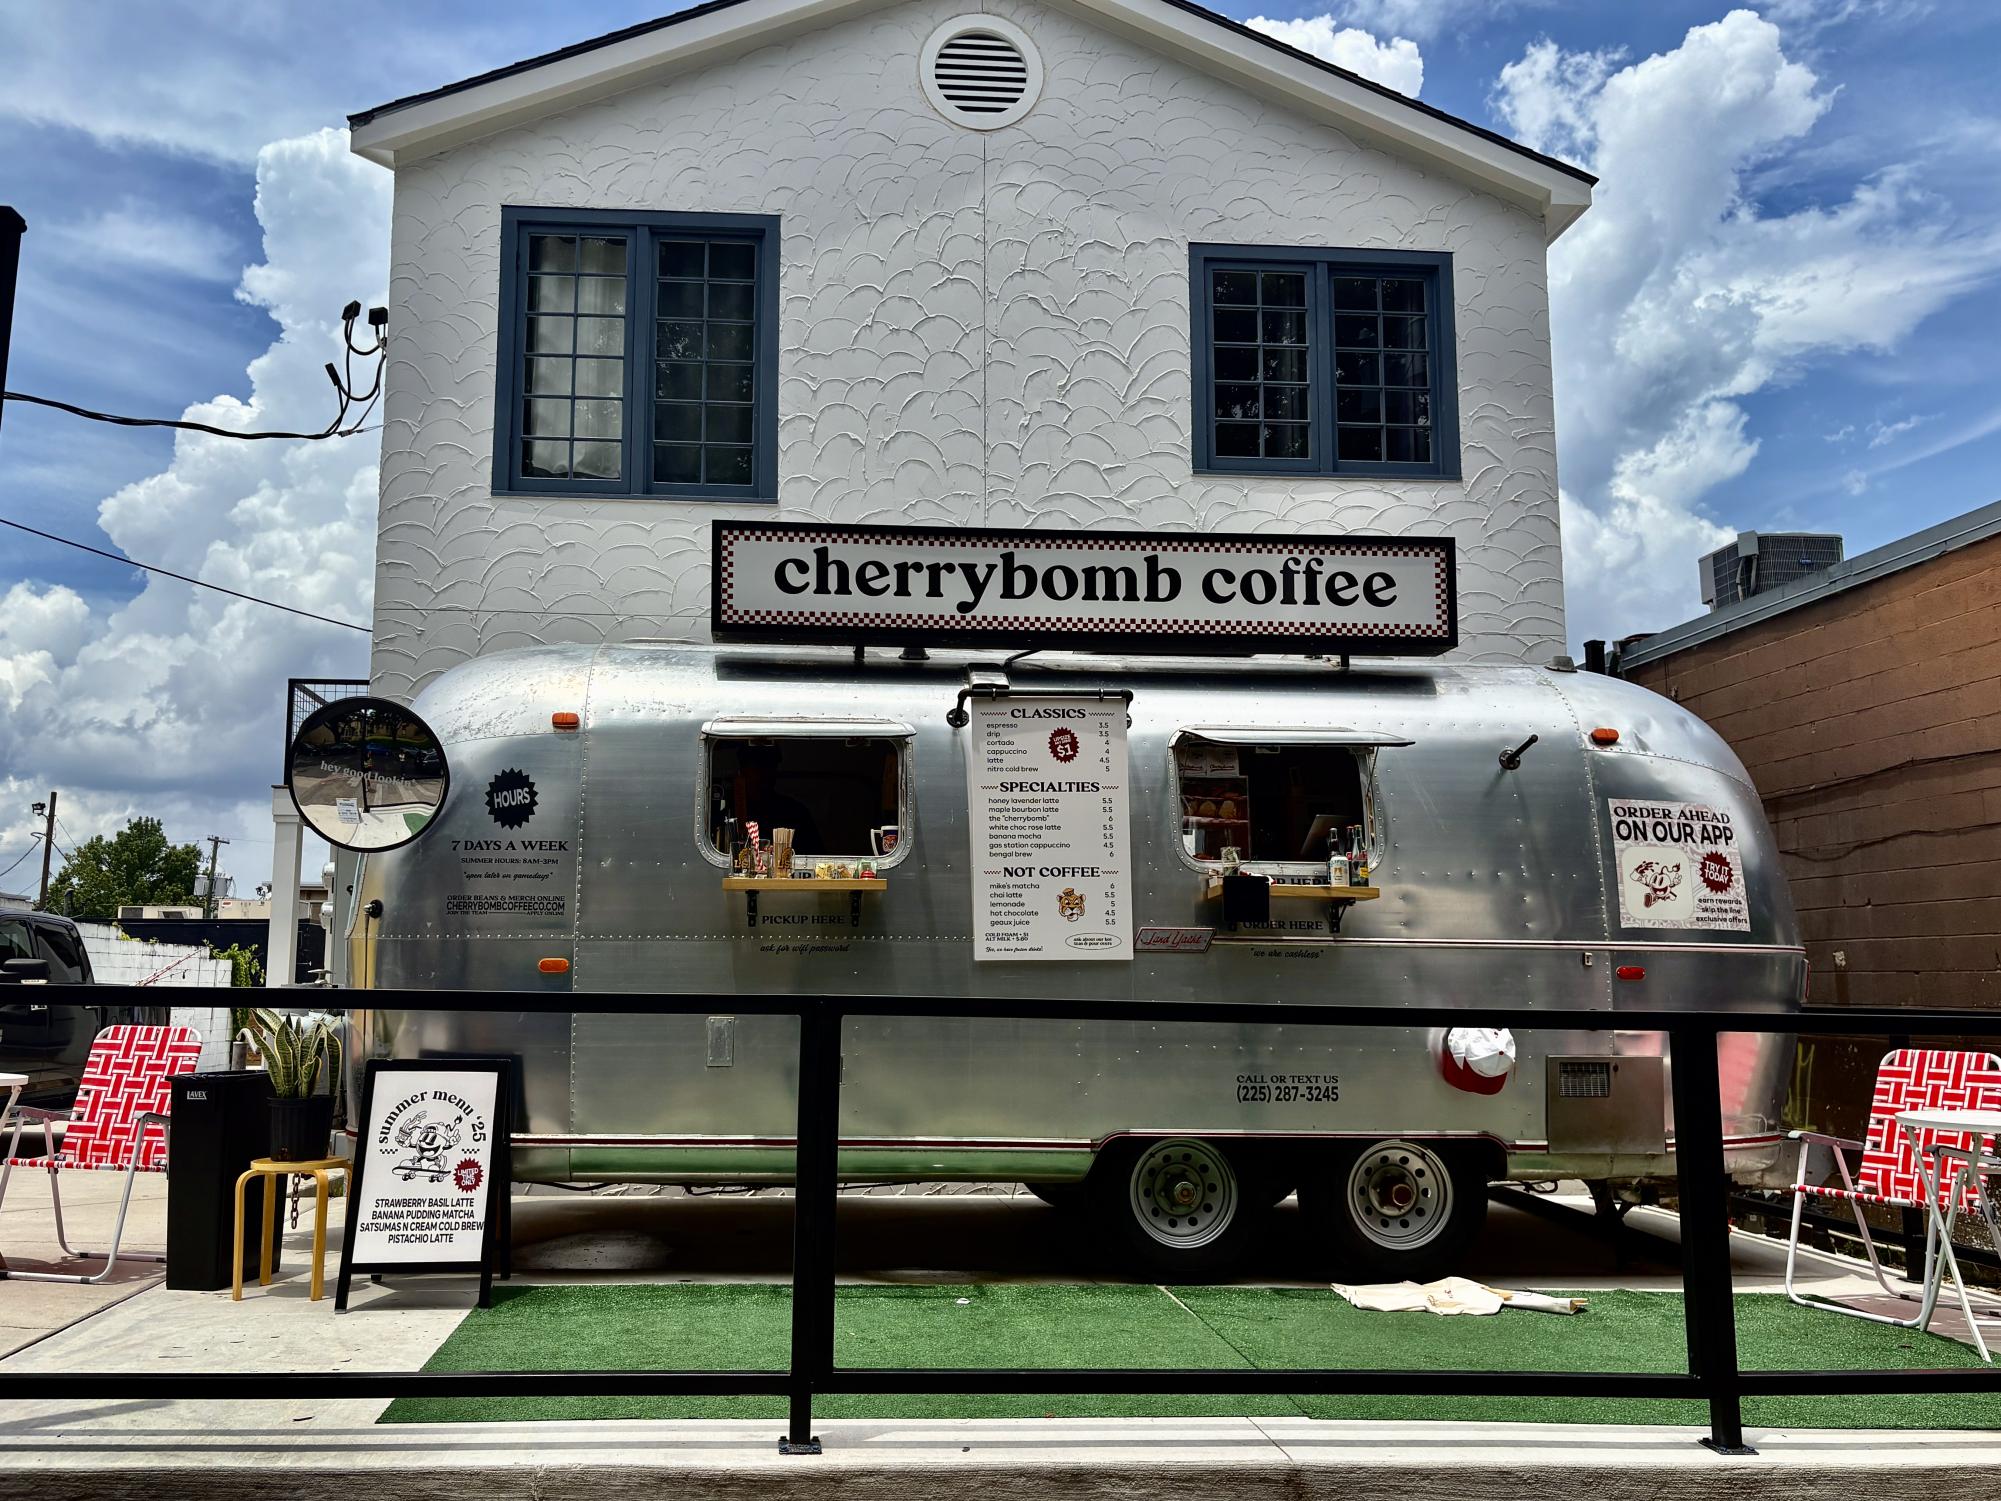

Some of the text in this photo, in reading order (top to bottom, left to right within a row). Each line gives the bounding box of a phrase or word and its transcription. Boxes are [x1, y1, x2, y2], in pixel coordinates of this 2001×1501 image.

[774, 545, 1398, 614] cherrybomb coffee
[1011, 708, 1086, 718] CLASSICS
[1057, 744, 1074, 758] $1
[320, 760, 341, 772] hey
[343, 768, 372, 780] good
[1000, 781, 1100, 792] SPECIALTIES
[493, 787, 531, 809] HOURS
[1002, 814, 1050, 822] "cherrybomb"
[1613, 806, 1730, 824] ORDER AHEAD
[1615, 820, 1734, 846] ON OUR APP
[451, 840, 569, 851] 7 DAYS A WEEK
[1003, 867, 1100, 877] NOT COFFEE
[1705, 860, 1729, 876] TRY IT
[1704, 869, 1729, 884] TODAY
[446, 901, 565, 911] CHERRYBOMBCOFFEECO.COM
[1701, 906, 1716, 914] skip
[762, 915, 845, 925] PICKUP HERE
[1012, 919, 1030, 927] juice
[1243, 920, 1323, 929] ORDER HERE
[1728, 916, 1748, 924] offers
[1141, 931, 1202, 948] Land Yacht
[1236, 1075, 1339, 1084] CALL OR TEXT US
[186, 1090, 208, 1100] LAVEX
[1236, 1085, 1339, 1104] (225) 287-3245
[379, 1091, 428, 1144] summer
[432, 1090, 474, 1117] menu
[457, 1168, 478, 1176] LIMITED
[461, 1178, 476, 1186] ONLY
[375, 1198, 474, 1208] STRAWBERRY BASIL LATTE
[372, 1210, 475, 1220] BANANA PUDDING MATCHA
[360, 1221, 485, 1232] SATSUMAS N CREAM COLD BREW
[388, 1234, 454, 1244] PISTACHIO LATTE
